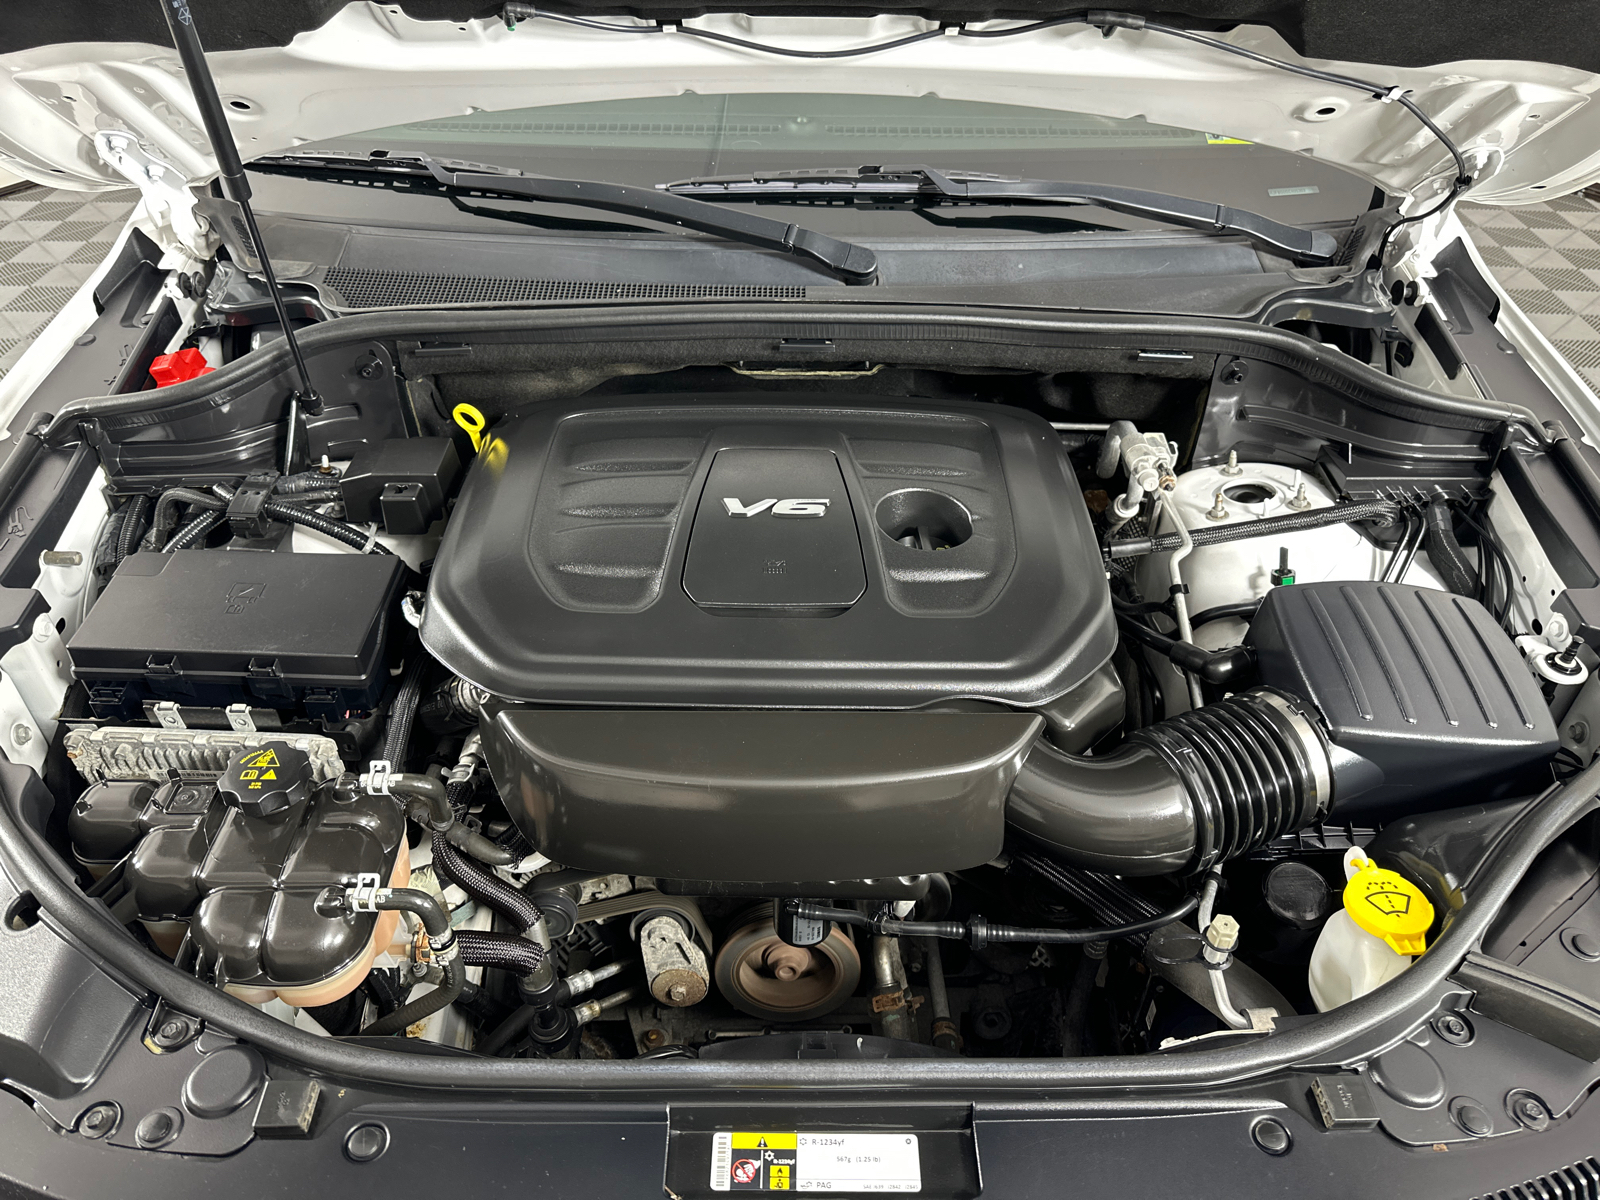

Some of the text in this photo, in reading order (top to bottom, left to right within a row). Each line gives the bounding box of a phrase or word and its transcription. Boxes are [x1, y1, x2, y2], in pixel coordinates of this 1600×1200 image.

[721, 497, 831, 517] V6
[811, 1138, 845, 1147] R-1234yf
[816, 1181, 832, 1189] PAG
